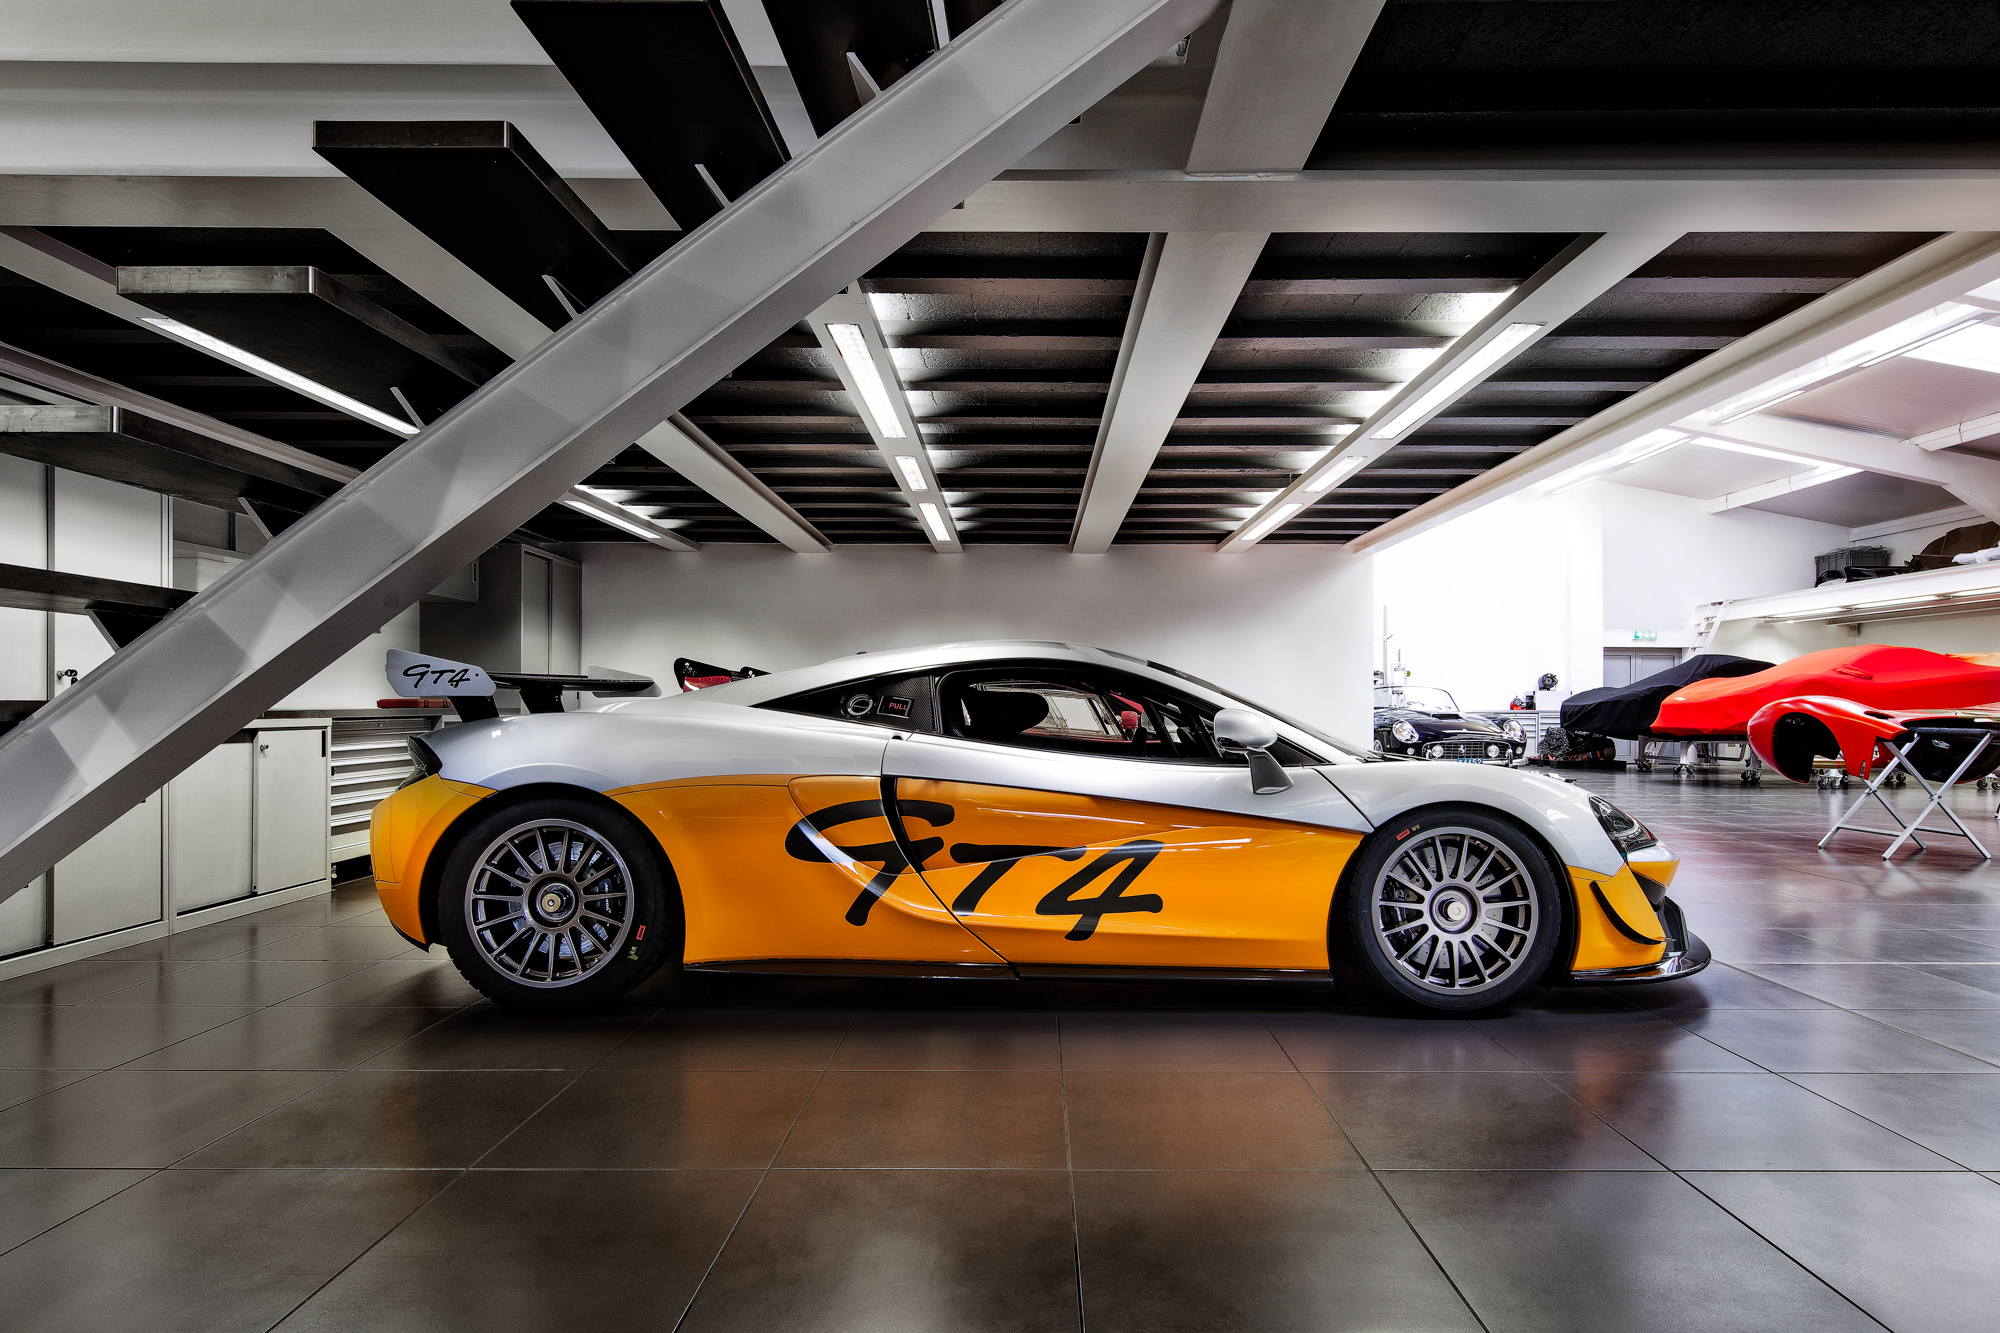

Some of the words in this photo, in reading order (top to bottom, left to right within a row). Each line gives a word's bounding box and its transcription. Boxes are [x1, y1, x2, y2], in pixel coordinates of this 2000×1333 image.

[402, 664, 471, 689] GT4
[889, 702, 907, 711] PULL
[784, 799, 1165, 942] GT4
